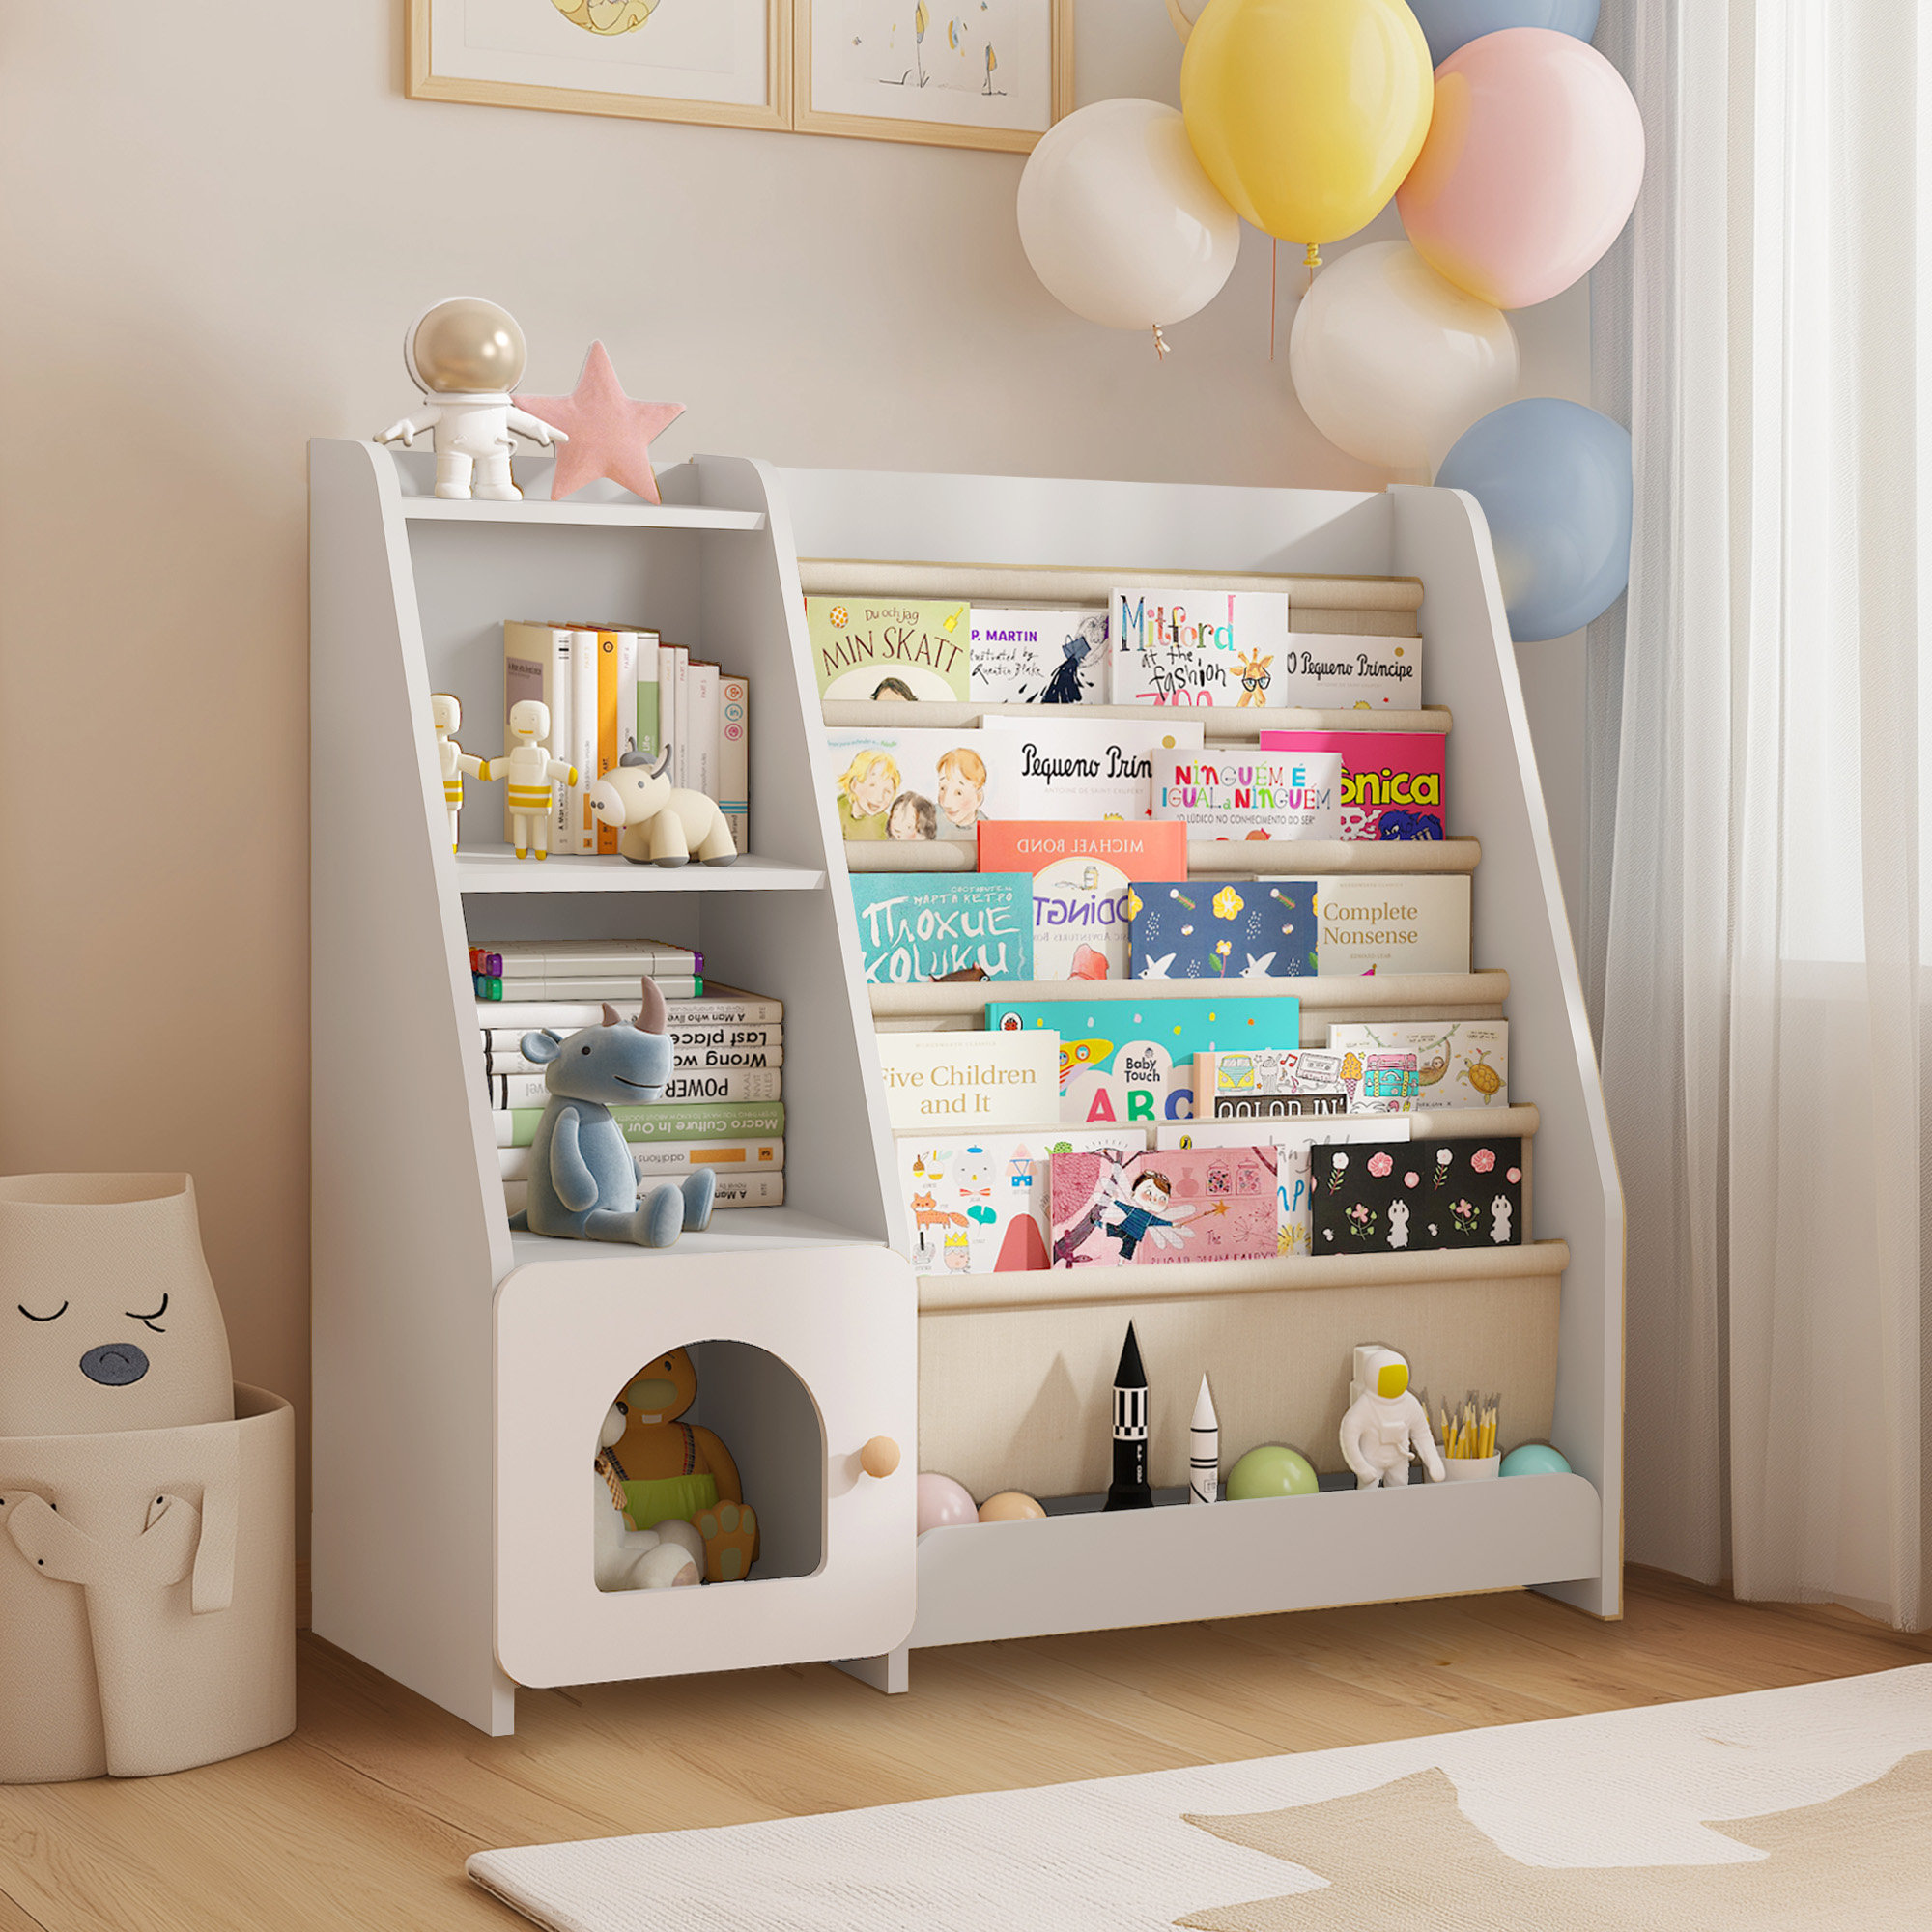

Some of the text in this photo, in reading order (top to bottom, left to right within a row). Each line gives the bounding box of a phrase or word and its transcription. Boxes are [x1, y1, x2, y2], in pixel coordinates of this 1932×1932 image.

[865, 608, 920, 626] Du och jag
[1119, 593, 1237, 652] Mitford
[971, 629, 1037, 642] P. MARTIN
[821, 626, 965, 677] MIN SKATT
[1141, 645, 1194, 668] at the
[1287, 651, 1414, 682] O Pequeno Príncipe
[1148, 658, 1228, 702] fashion
[641, 735, 650, 751] Life
[1020, 742, 1153, 786] Pequeno Prín
[1292, 763, 1307, 787] É
[1341, 767, 1440, 807] ônica
[1161, 787, 1222, 810] IGUAL
[1322, 901, 1418, 924] Complete
[1322, 927, 1418, 946] Nonsense
[687, 1013, 710, 1023] who
[711, 1013, 735, 1022] Man
[737, 1013, 746, 1022] A
[730, 1032, 767, 1047] Last
[705, 1050, 767, 1068] Wrong
[1125, 1058, 1157, 1071] Baby
[930, 1065, 1037, 1088] Children
[1123, 1069, 1160, 1083] Touch
[665, 1077, 728, 1098] POWER
[920, 1093, 991, 1115] and It
[627, 1118, 779, 1134] Macro Culture In Our
[739, 1190, 747, 1199] A
